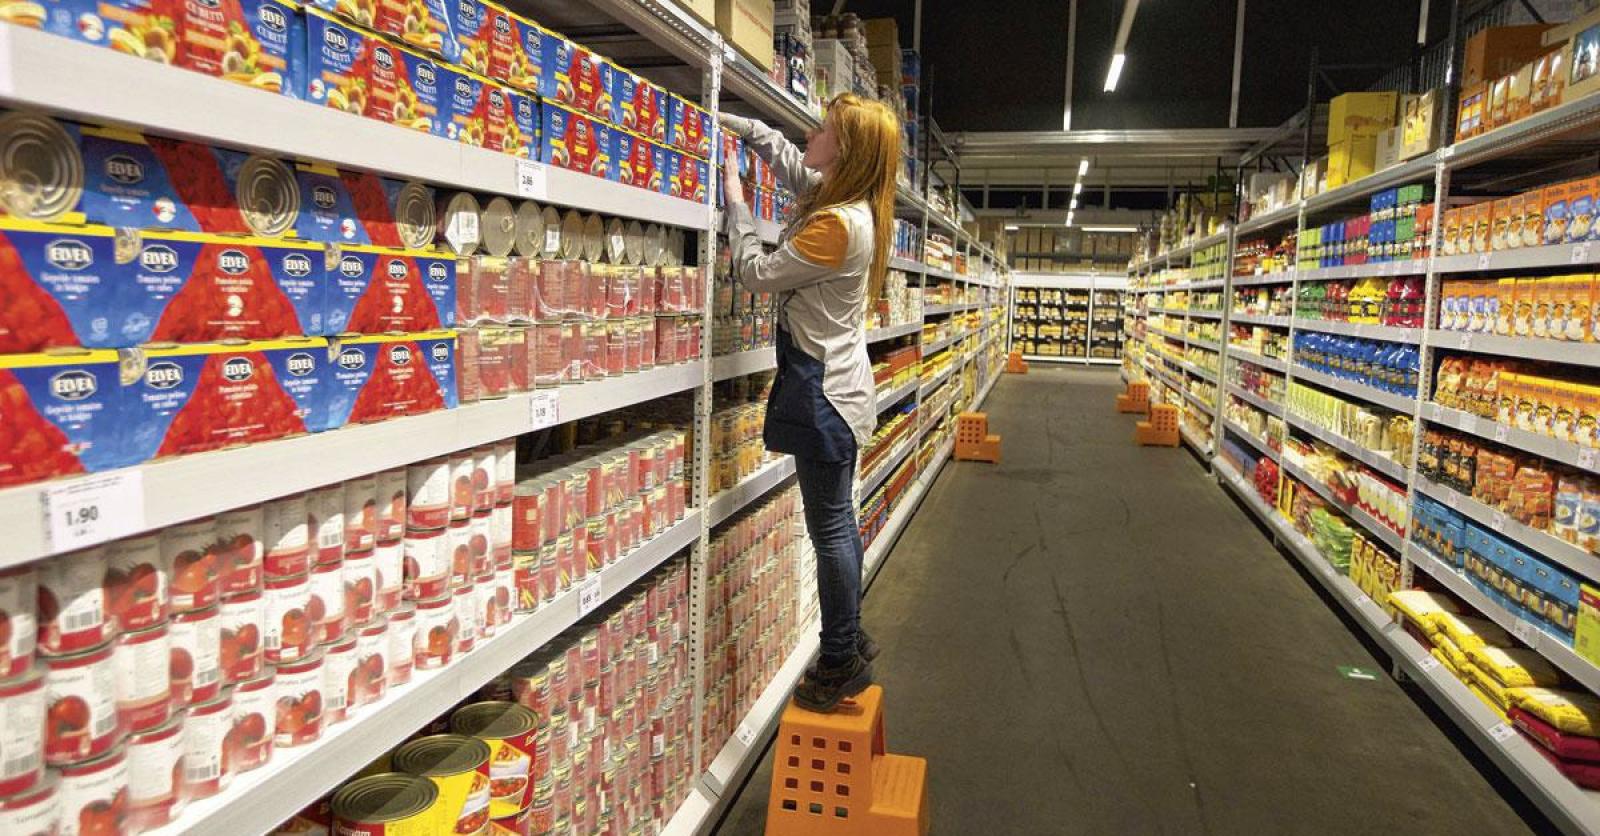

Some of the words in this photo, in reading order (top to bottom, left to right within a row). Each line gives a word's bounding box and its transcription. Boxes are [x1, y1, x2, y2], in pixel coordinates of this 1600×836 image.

[259, 7, 286, 27] ELVEA
[326, 31, 346, 46] ELVEA
[107, 162, 142, 177] ELVEA
[51, 247, 91, 263] ELVEA
[143, 252, 177, 266] ELVEA
[222, 255, 249, 268] ELVEA
[286, 258, 310, 270] ELVEA
[341, 260, 362, 272] ELVEA
[289, 360, 313, 372] ELVEA
[340, 354, 364, 366] ELVEA
[149, 368, 181, 382] ELVEA
[225, 363, 253, 376] ELVEA
[53, 378, 95, 393] ELVEA
